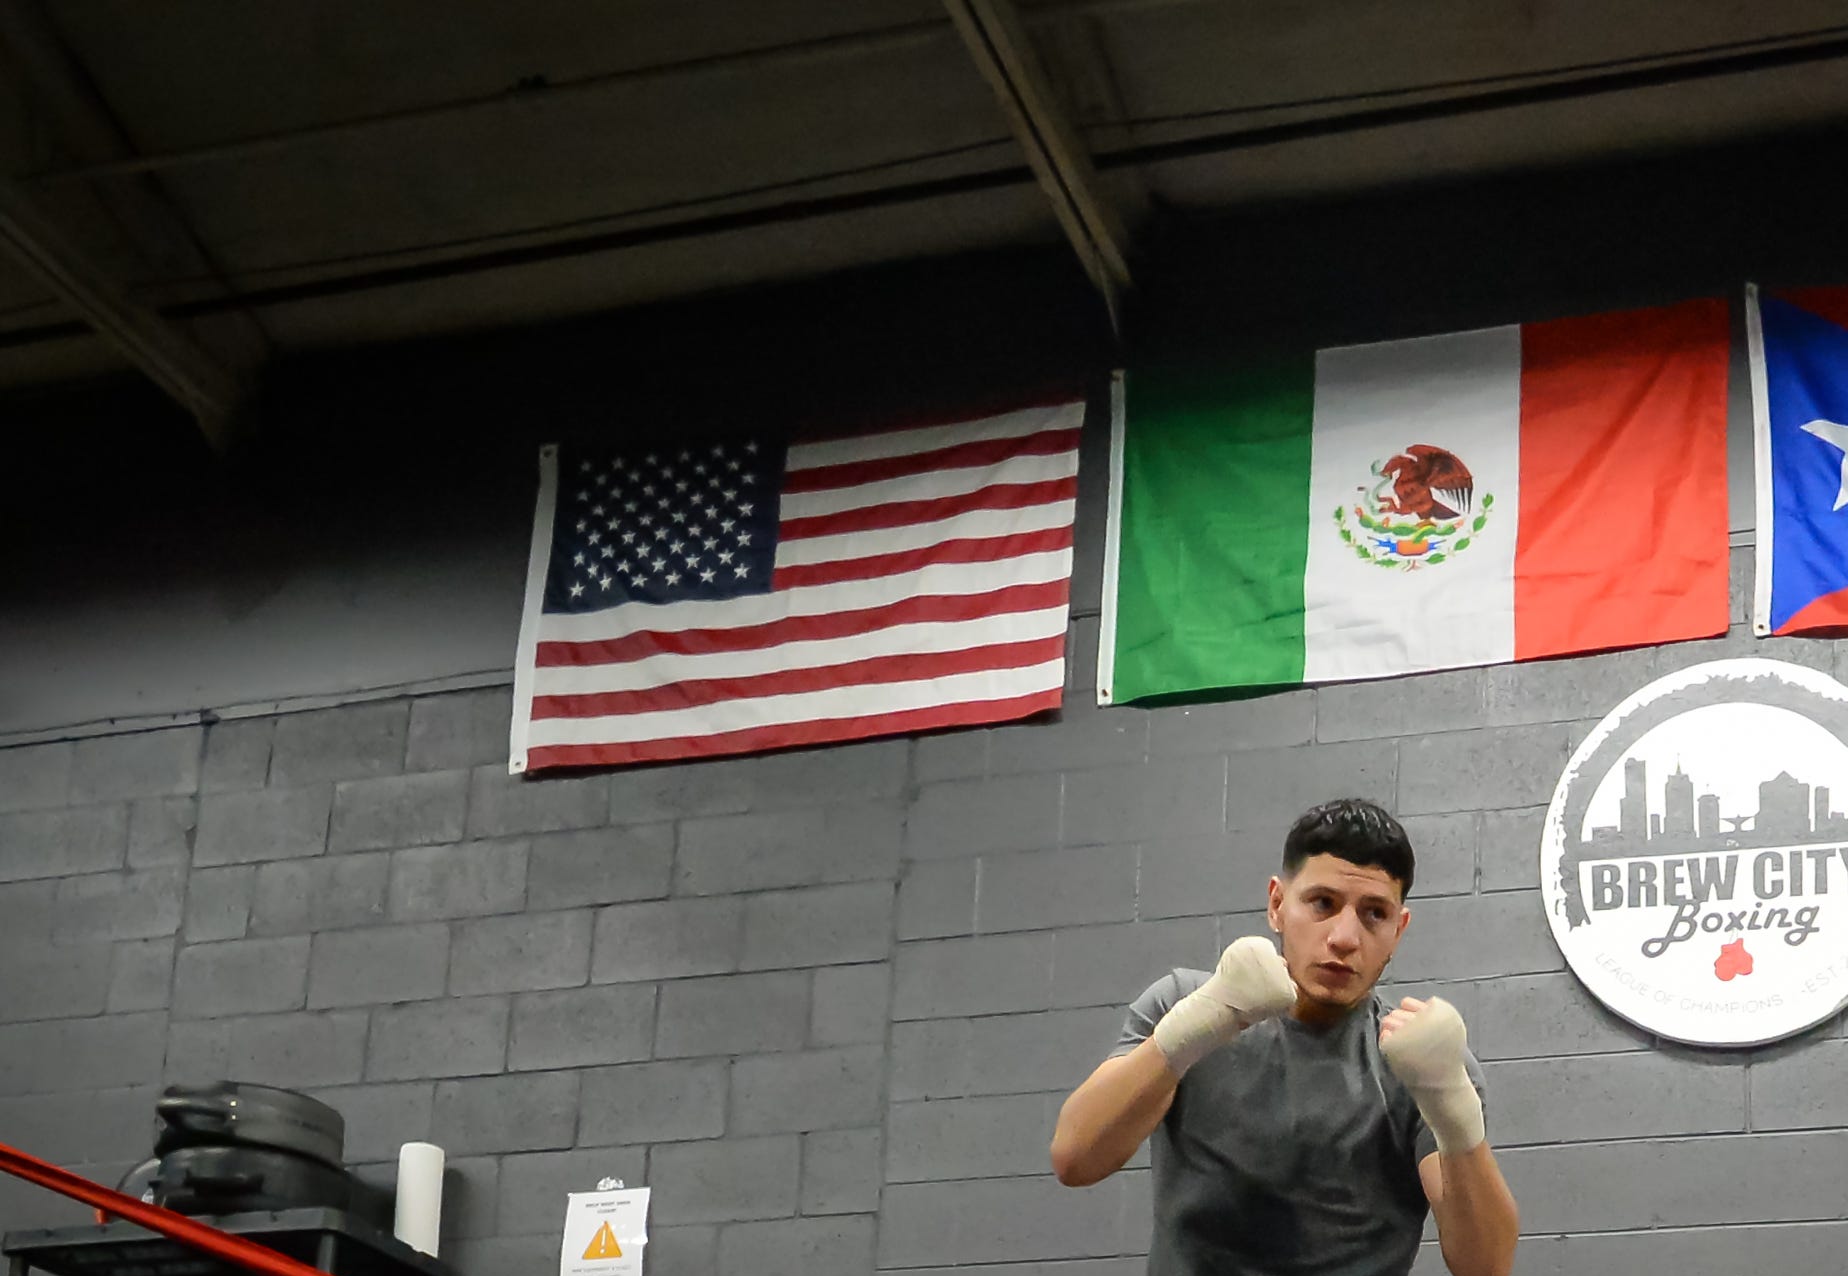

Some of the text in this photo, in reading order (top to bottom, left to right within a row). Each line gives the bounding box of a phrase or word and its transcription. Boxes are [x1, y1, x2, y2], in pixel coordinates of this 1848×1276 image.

[1591, 855, 1739, 911] BREW
[1641, 900, 1820, 958] Boxing
[1595, 952, 1784, 1015] LEAGUE OF CHAMPIONS
